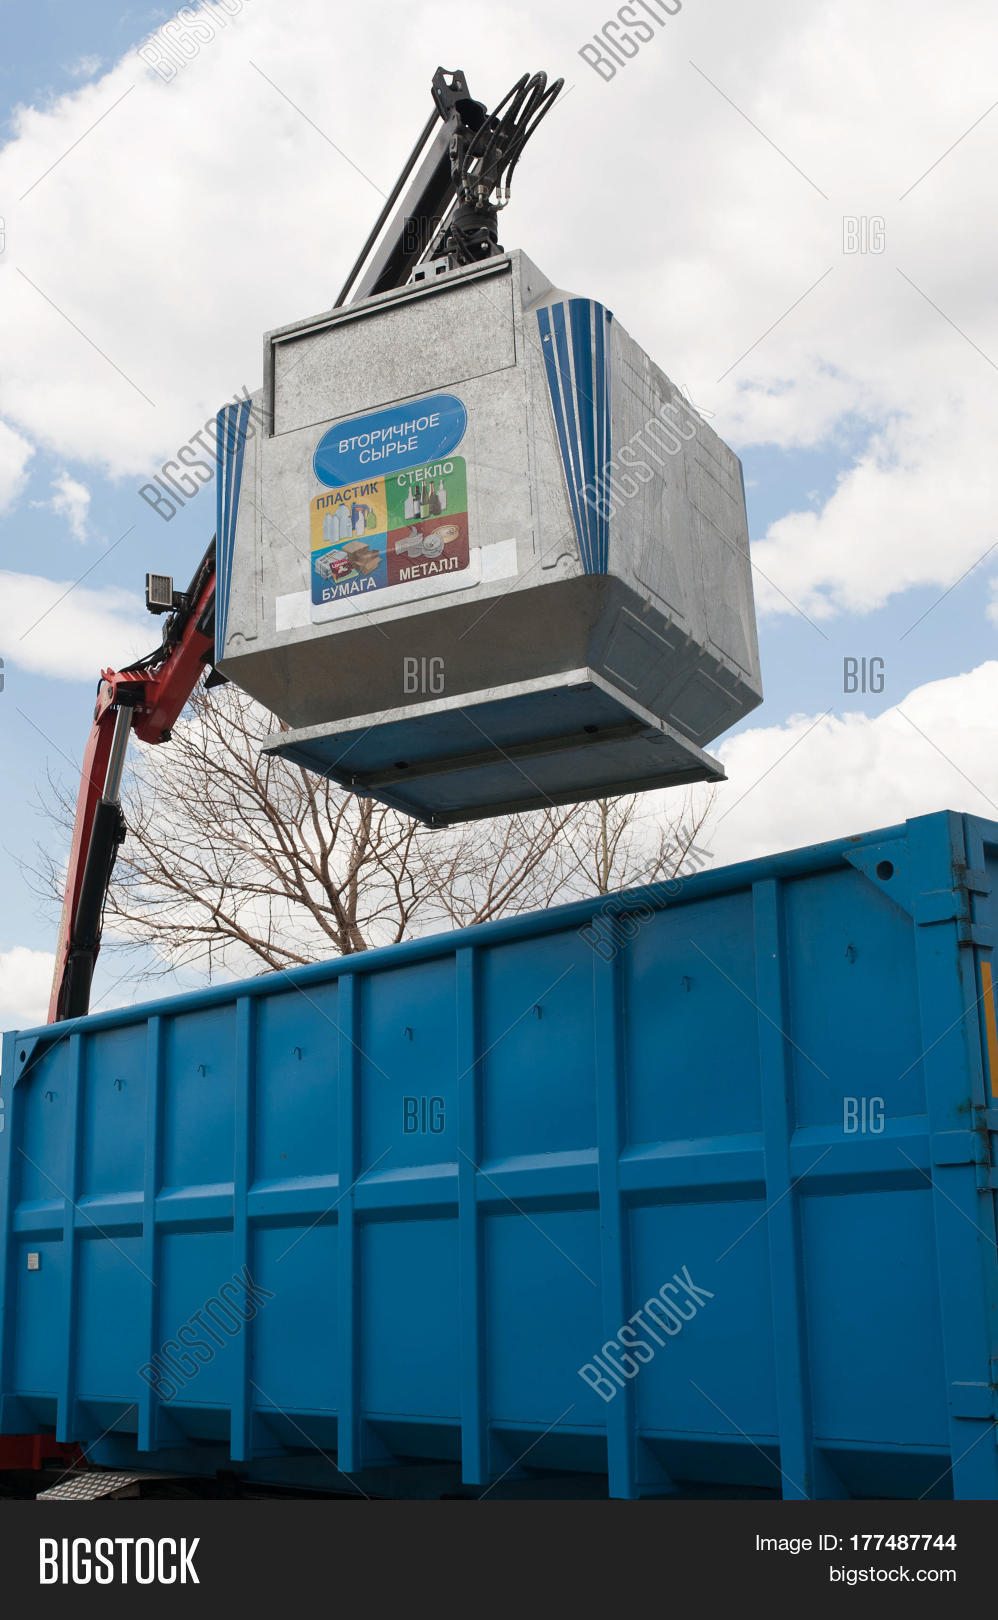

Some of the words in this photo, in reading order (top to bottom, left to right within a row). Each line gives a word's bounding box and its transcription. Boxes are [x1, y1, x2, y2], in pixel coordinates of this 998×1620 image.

[338, 412, 441, 454] ВТОРИЧНОЕ
[359, 436, 418, 464] СЫРЬЕ
[397, 461, 454, 487] СТЕКЛО
[316, 481, 378, 510] ПЛАСТИК
[399, 556, 459, 581] МЕТАЛЛ
[322, 576, 377, 601] БУМАГА
